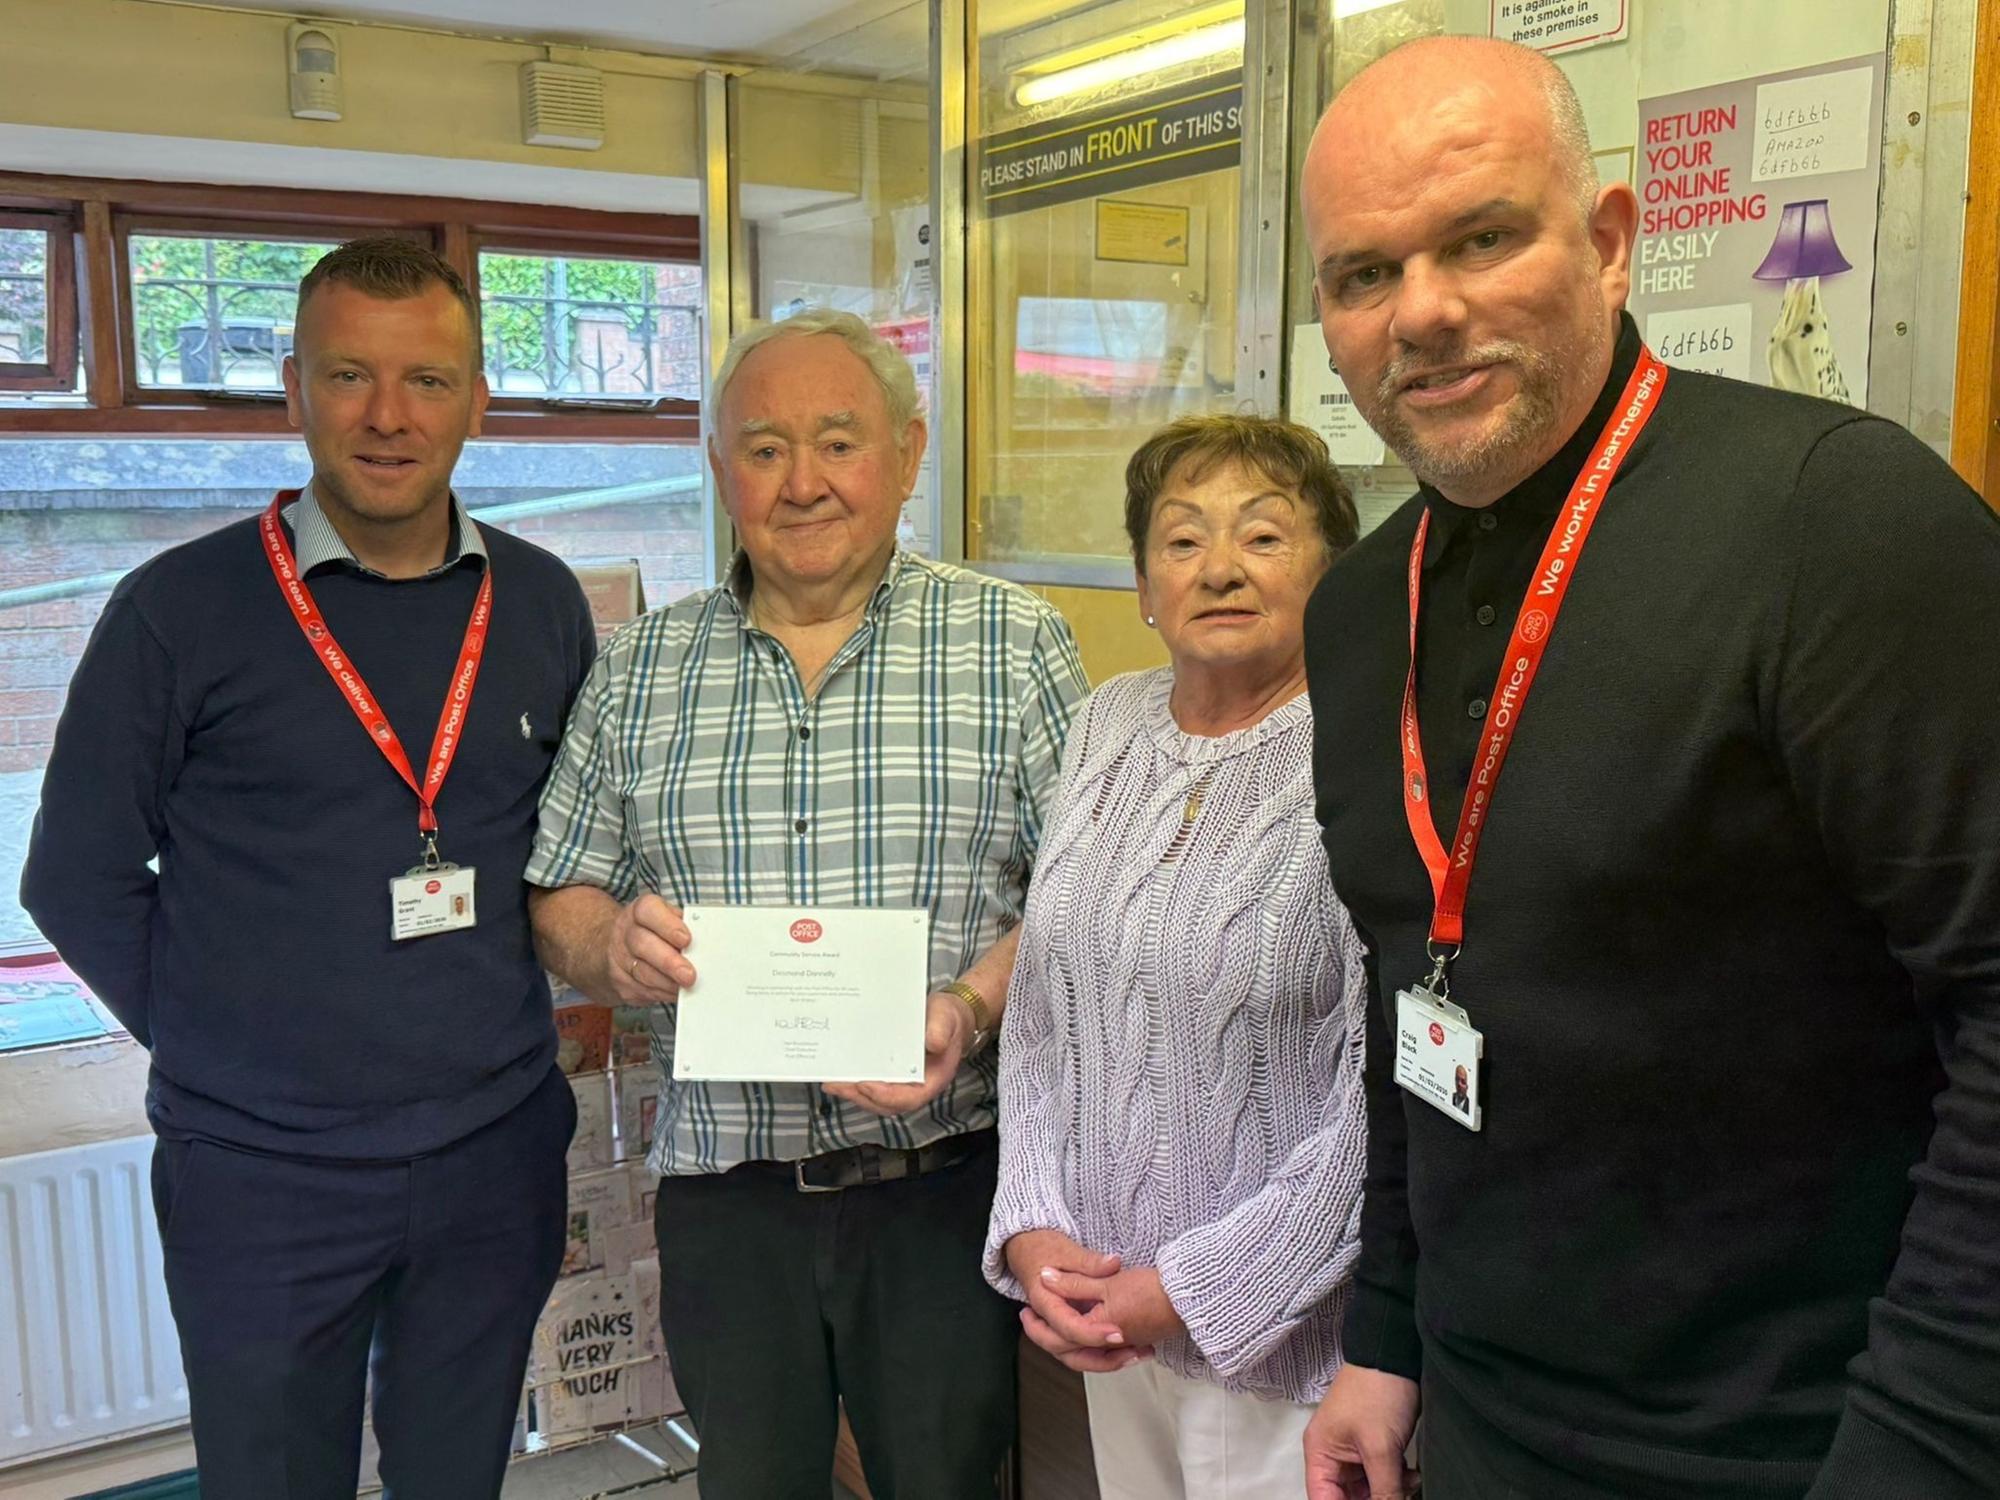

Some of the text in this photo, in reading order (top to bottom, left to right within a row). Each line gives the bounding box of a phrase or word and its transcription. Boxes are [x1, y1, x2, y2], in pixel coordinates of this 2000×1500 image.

[1502, 6, 1509, 18] It
[1512, 3, 1522, 15] is
[1513, 13, 1599, 42] these premises
[1523, 1, 1588, 26] to smoke in
[1646, 104, 1736, 145] RETURN
[981, 162, 1024, 188] PLEASE
[1026, 150, 1067, 178] STAND
[1069, 145, 1084, 168] IN
[1086, 118, 1157, 164] FRONT
[1161, 121, 1184, 145] OF
[1184, 110, 1223, 139] THIS
[1646, 140, 1712, 174] YOUR
[1644, 168, 1731, 204] ONLINE
[1643, 194, 1766, 235] SHOPPING
[1641, 230, 1719, 265] EASILY
[1640, 264, 1695, 296] HERE
[1537, 368, 1660, 597] We work in partnership
[268, 532, 280, 552] are
[275, 553, 292, 579] one
[288, 580, 310, 616] team
[474, 604, 488, 627] We
[324, 645, 374, 715] We deliver
[429, 659, 475, 785] We are Post Office
[1455, 656, 1529, 869] We are Post Office
[791, 930, 819, 938] OFFICE
[796, 922, 817, 931] POST
[1401, 1029, 1417, 1045] Craig
[1401, 1040, 1418, 1055] Black
[558, 1341, 616, 1372] VERY
